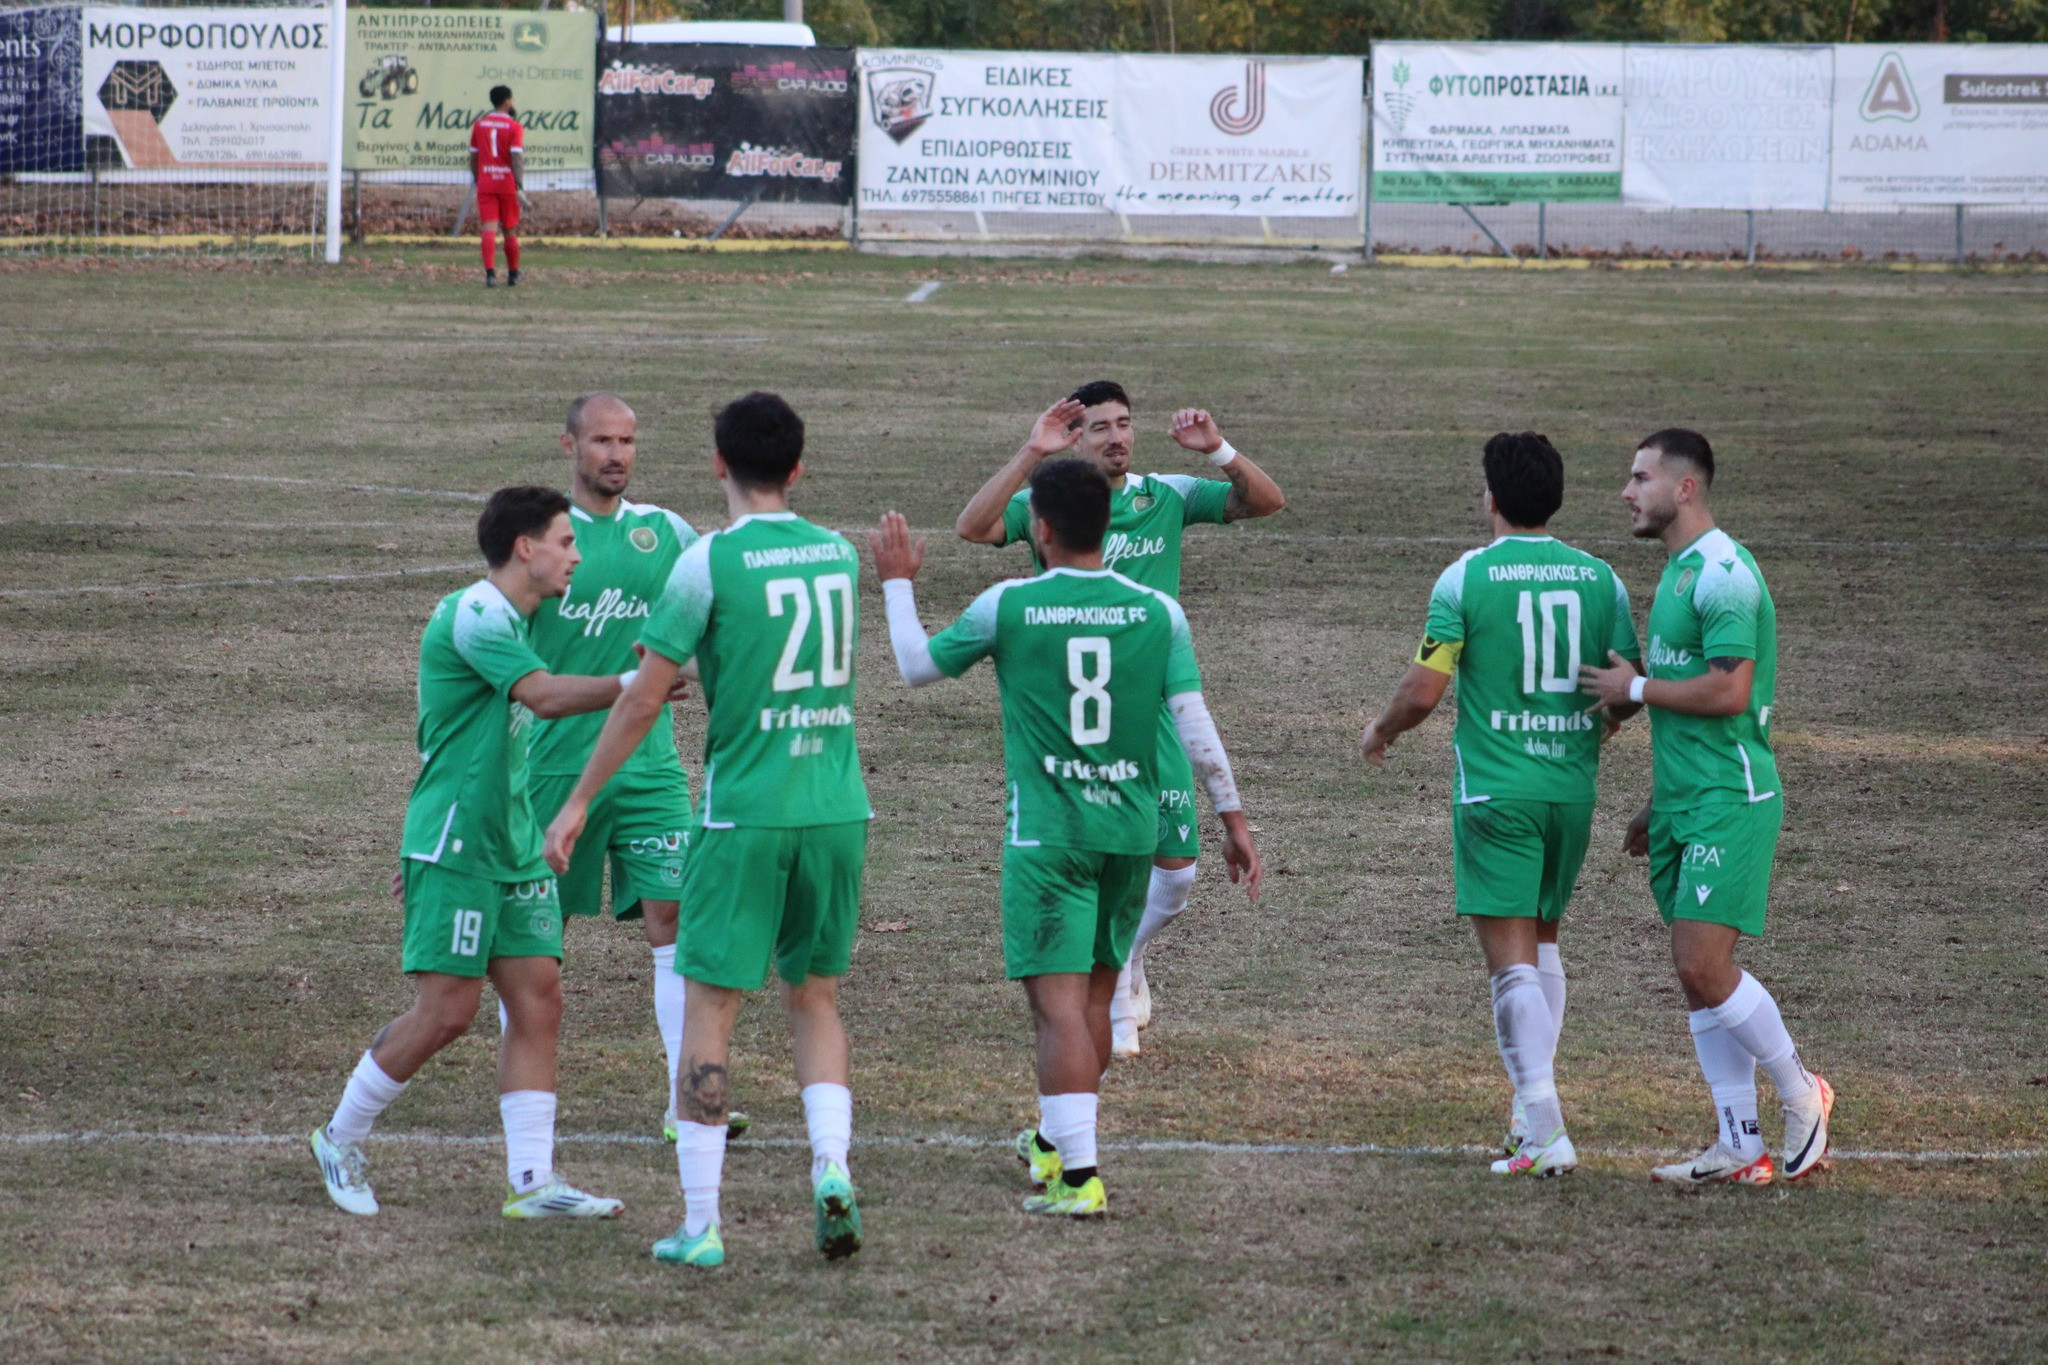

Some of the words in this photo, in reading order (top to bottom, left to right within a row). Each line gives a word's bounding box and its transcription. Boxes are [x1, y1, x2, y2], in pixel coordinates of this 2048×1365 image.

[358, 14, 503, 28] ΑΝΤΙΠΡΟΣΩΠΕΙΕΣ
[89, 23, 328, 49] ΜΟΡΦΟΠΟΥΛΟΣ
[358, 30, 415, 40] ΓΕΩΡΓΙΚΩΝ
[418, 31, 505, 41] ΜΗΧΑΝΗΜΑΤΩΝ
[365, 42, 408, 51] ΤΡΑΚΤΕΡ
[418, 43, 498, 52] ΑΝΤΑΛΛΑΚΤΙΚΑ
[196, 61, 244, 71] ΣΙΔΗΡΟΣ
[248, 61, 296, 71] ΜΠΕΤΟΝ
[196, 79, 241, 89] ΔΟΜΙΚΑ
[244, 79, 278, 88] ΥΛΙΚΑ
[598, 68, 715, 100] AllForCar.gr
[986, 67, 1072, 87] ΕΙΔΙΚΕΣ
[1429, 75, 1590, 96] ΦΥΤΟΠΡΟΣΤΑΣΙΑ
[1631, 55, 1827, 99] ΠΑΡΟΥΣΙΑ
[1959, 80, 2040, 97] Sulcotrek
[196, 97, 259, 107] ΓΑΛΒΑΝΙΖΕ
[940, 97, 1109, 118] ΣΥΓΚΟΛΛΗΣΕΙΣ
[356, 102, 392, 130] Τα
[1638, 103, 1815, 130] ΑΙΘΟΥΣΕΣ
[1499, 125, 1570, 135] ΛΙΠΑΣΜΑΤΑ
[414, 142, 421, 151] &
[490, 128, 499, 158] 1
[921, 140, 1073, 159] ΕΠΙΔΙΟΡΘΩΣΕΙΣ
[1462, 139, 1524, 149] ΓΕΩΡΓΙΚΑ
[1529, 140, 1615, 149] ΜΗΧΑΝΗΜΑΤΑ
[1629, 135, 1825, 163] ΕΚΔΗΛΩΣΕΩΝ
[1850, 135, 1929, 151] ADAMA
[725, 150, 842, 182] AllForCar.gr
[1385, 153, 1459, 163] ΣΥΣΤΗΜΑΤΑ
[1535, 153, 1611, 163] ΖΩΟΤΡΟΦΕΣ
[887, 167, 969, 184] ΖΑΝΤΩΝ
[976, 169, 1100, 187] ΑΛΟΥΜΙΝΙΟΥ
[1149, 161, 1333, 183] DERMITZAKIS
[902, 190, 985, 203] 6975558861
[992, 191, 1042, 204] ΠΗΓΕΣ
[1047, 193, 1106, 206] ΝΕΣΤΟΥ
[1115, 184, 1148, 201] the
[1157, 191, 1241, 209] meaning
[1251, 187, 1275, 202] of
[1282, 187, 1355, 203] matter
[743, 543, 839, 570] ΠΑΝΘΡΑΚΙΚΟΣ
[1488, 564, 1578, 581] ΠΑΝΘΡΑΚΙΚΟΣ
[1580, 568, 1597, 581] FC
[559, 588, 651, 637] kaffein
[1024, 606, 1127, 625] ΠΑΝΘΡΑΚΙΚΟΣ
[1129, 607, 1147, 622] FC
[765, 572, 854, 692] 20
[1516, 589, 1582, 694] 10
[1066, 636, 1112, 746] 8
[760, 704, 853, 731] Friends
[1491, 709, 1594, 732] Friends
[1044, 755, 1139, 782] Friends
[450, 909, 483, 957] 19
